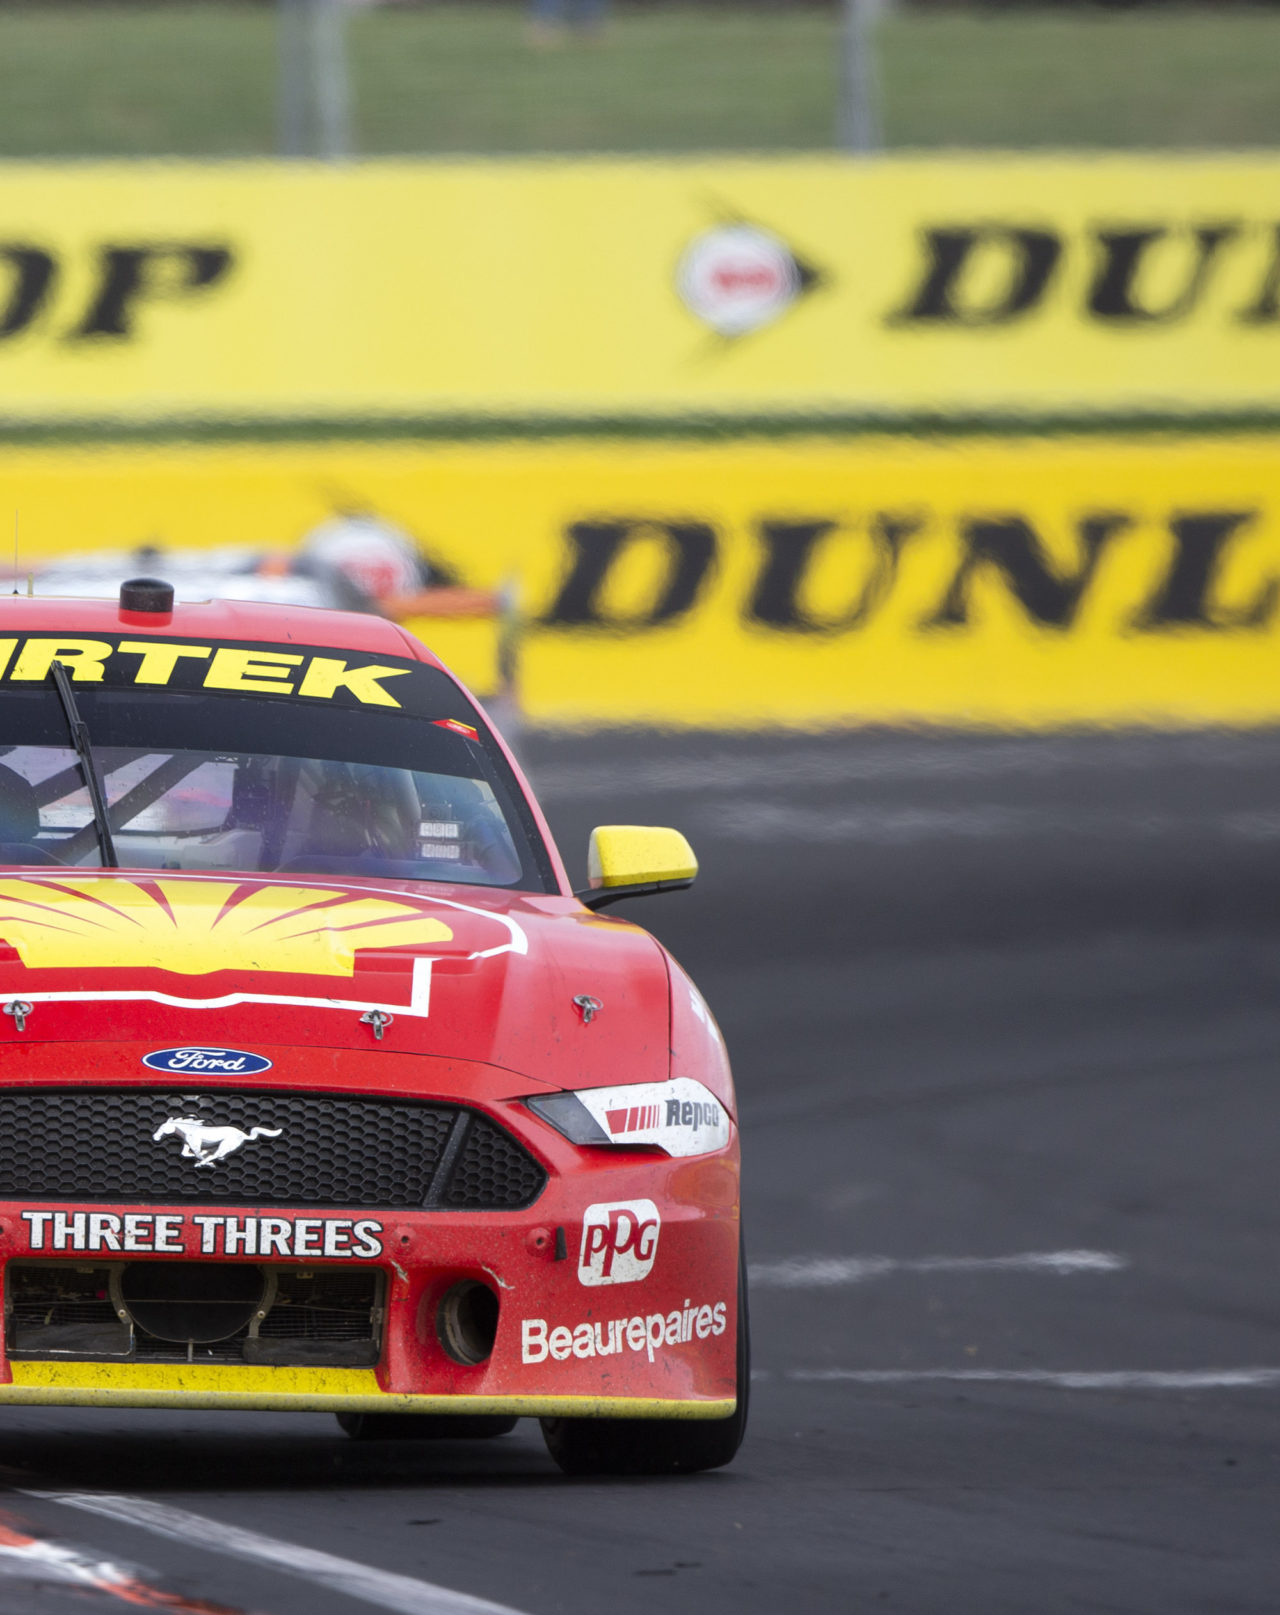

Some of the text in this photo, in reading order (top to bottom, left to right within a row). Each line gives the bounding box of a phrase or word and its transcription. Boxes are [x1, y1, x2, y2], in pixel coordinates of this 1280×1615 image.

[167, 1047, 246, 1074] Ford
[665, 1100, 719, 1132] Repco
[22, 1211, 384, 1258] THREE THREES
[582, 1208, 658, 1278] PPG
[521, 1298, 727, 1374] Beaurepaires
